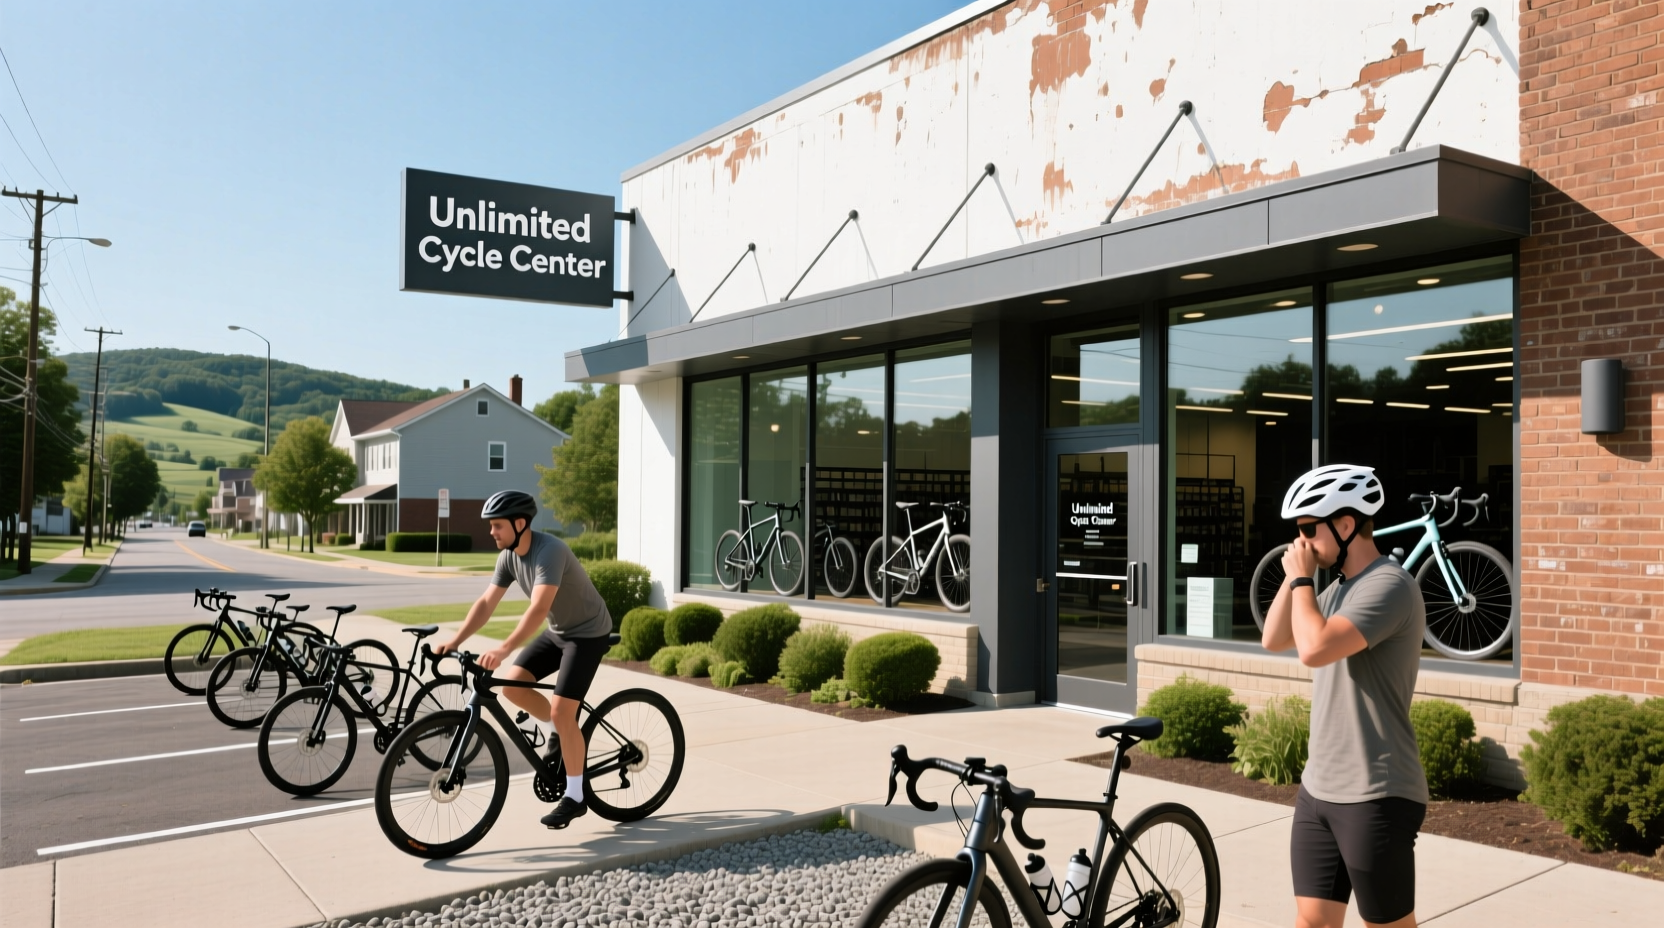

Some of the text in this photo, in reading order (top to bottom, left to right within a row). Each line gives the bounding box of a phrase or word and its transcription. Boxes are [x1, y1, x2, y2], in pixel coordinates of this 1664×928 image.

[429, 195, 591, 244] Unlimited
[418, 235, 606, 279] Cycle Center
